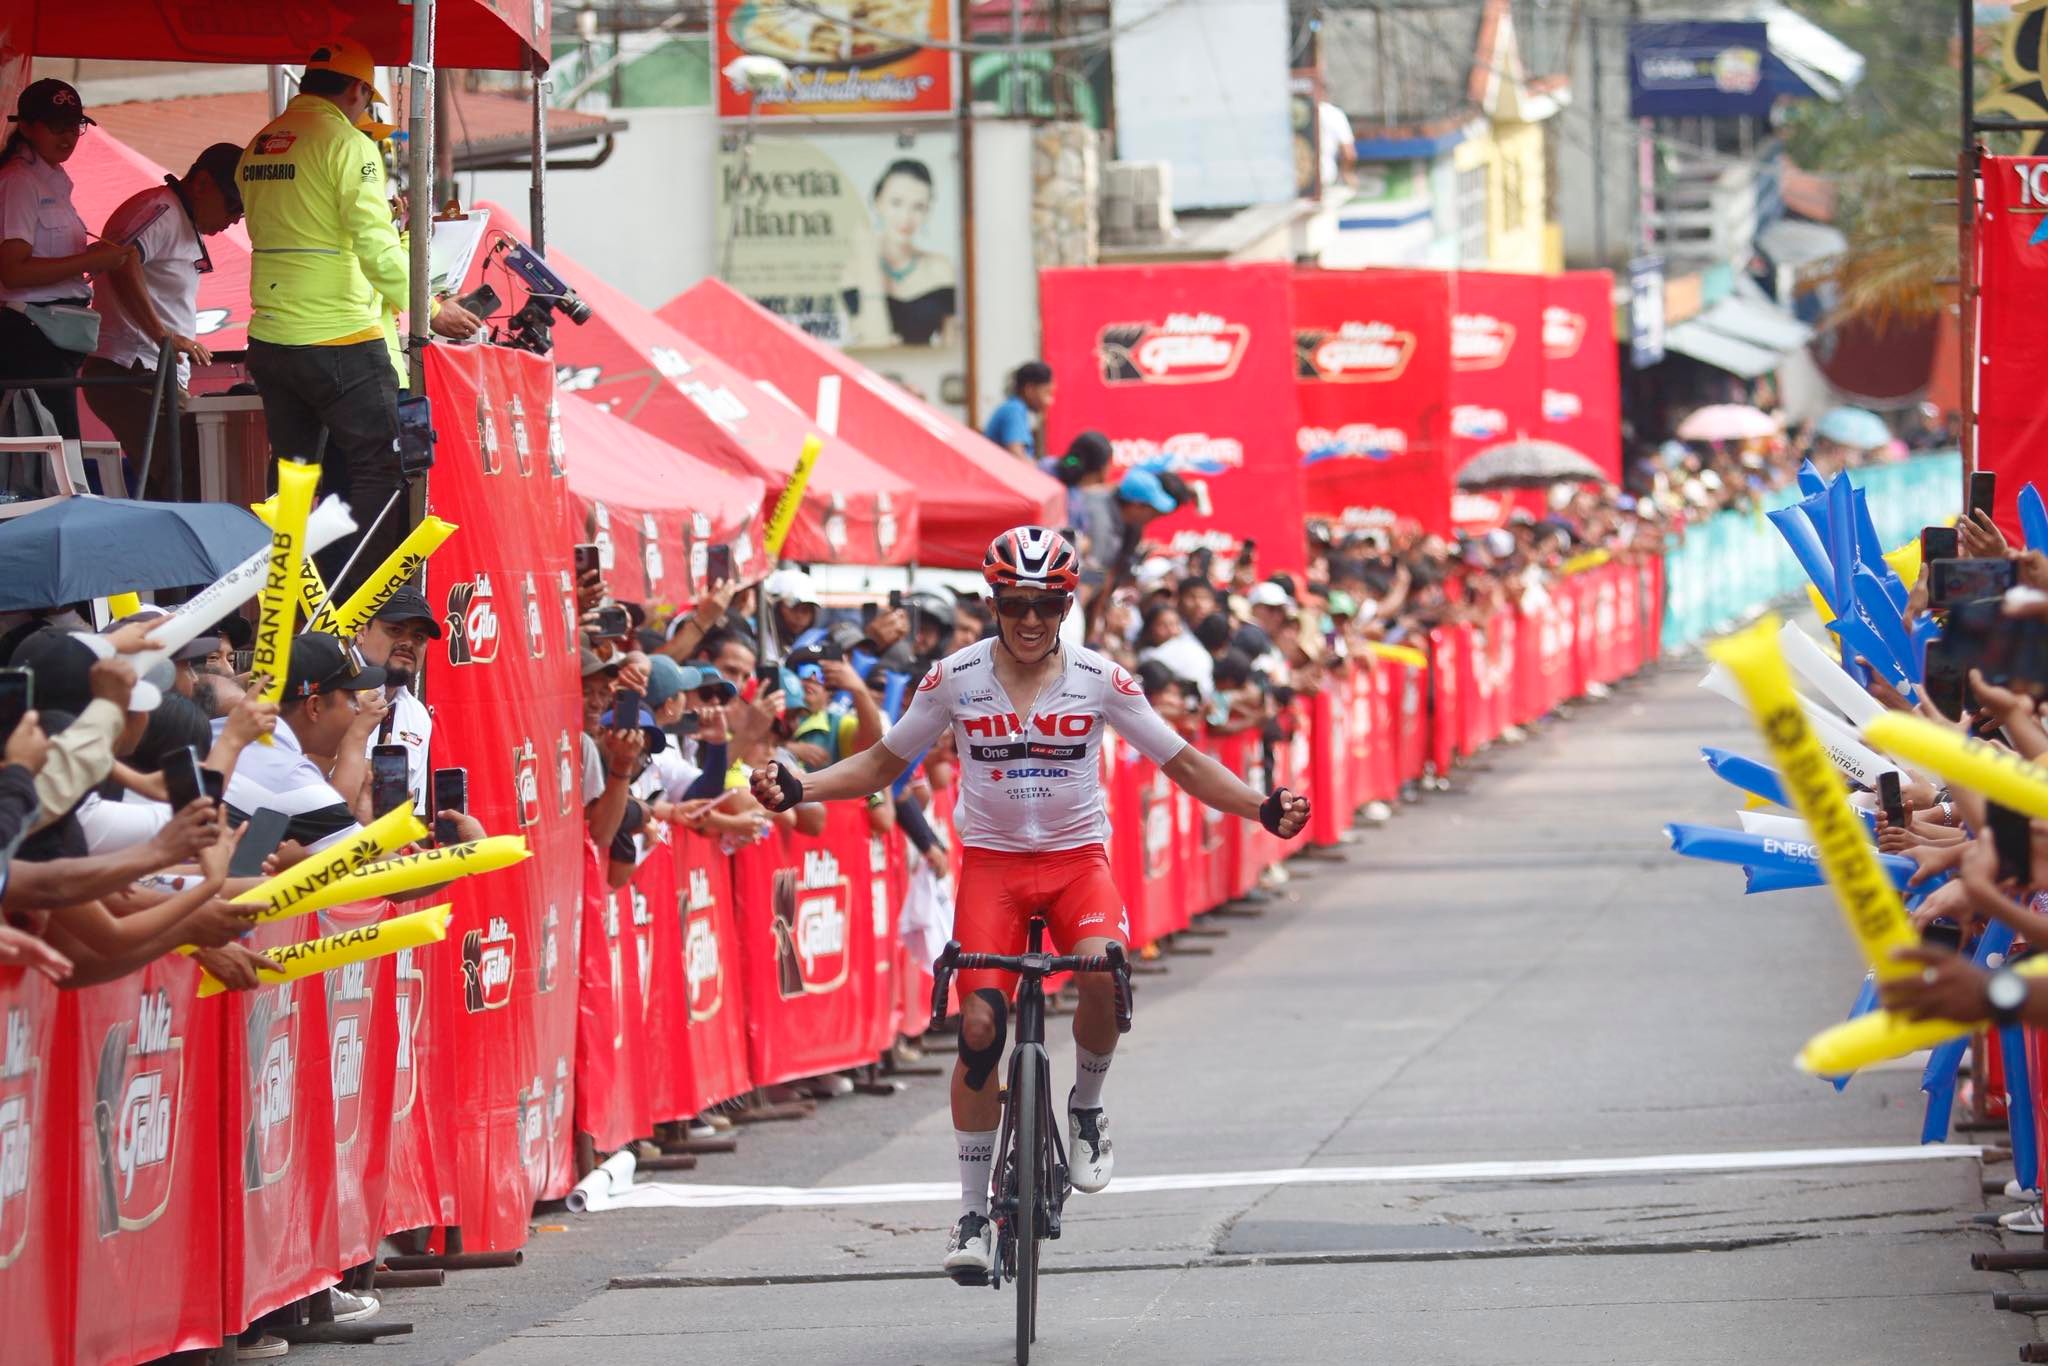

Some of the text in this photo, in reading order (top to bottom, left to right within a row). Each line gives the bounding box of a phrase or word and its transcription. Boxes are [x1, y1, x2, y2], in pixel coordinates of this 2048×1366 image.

[243, 164, 295, 181] COMISARIO
[255, 532, 293, 665] BANTRAB
[953, 658, 981, 673] HINO
[1074, 662, 1102, 675] HINO
[982, 747, 1009, 759] One
[1831, 745, 1861, 767] SEGUROS
[1007, 769, 1068, 778] SUZUKI
[798, 896, 843, 977] Gallo
[481, 946, 511, 997] Gallo
[118, 1072, 170, 1204] Gallo
[959, 1153, 991, 1161] HINO
